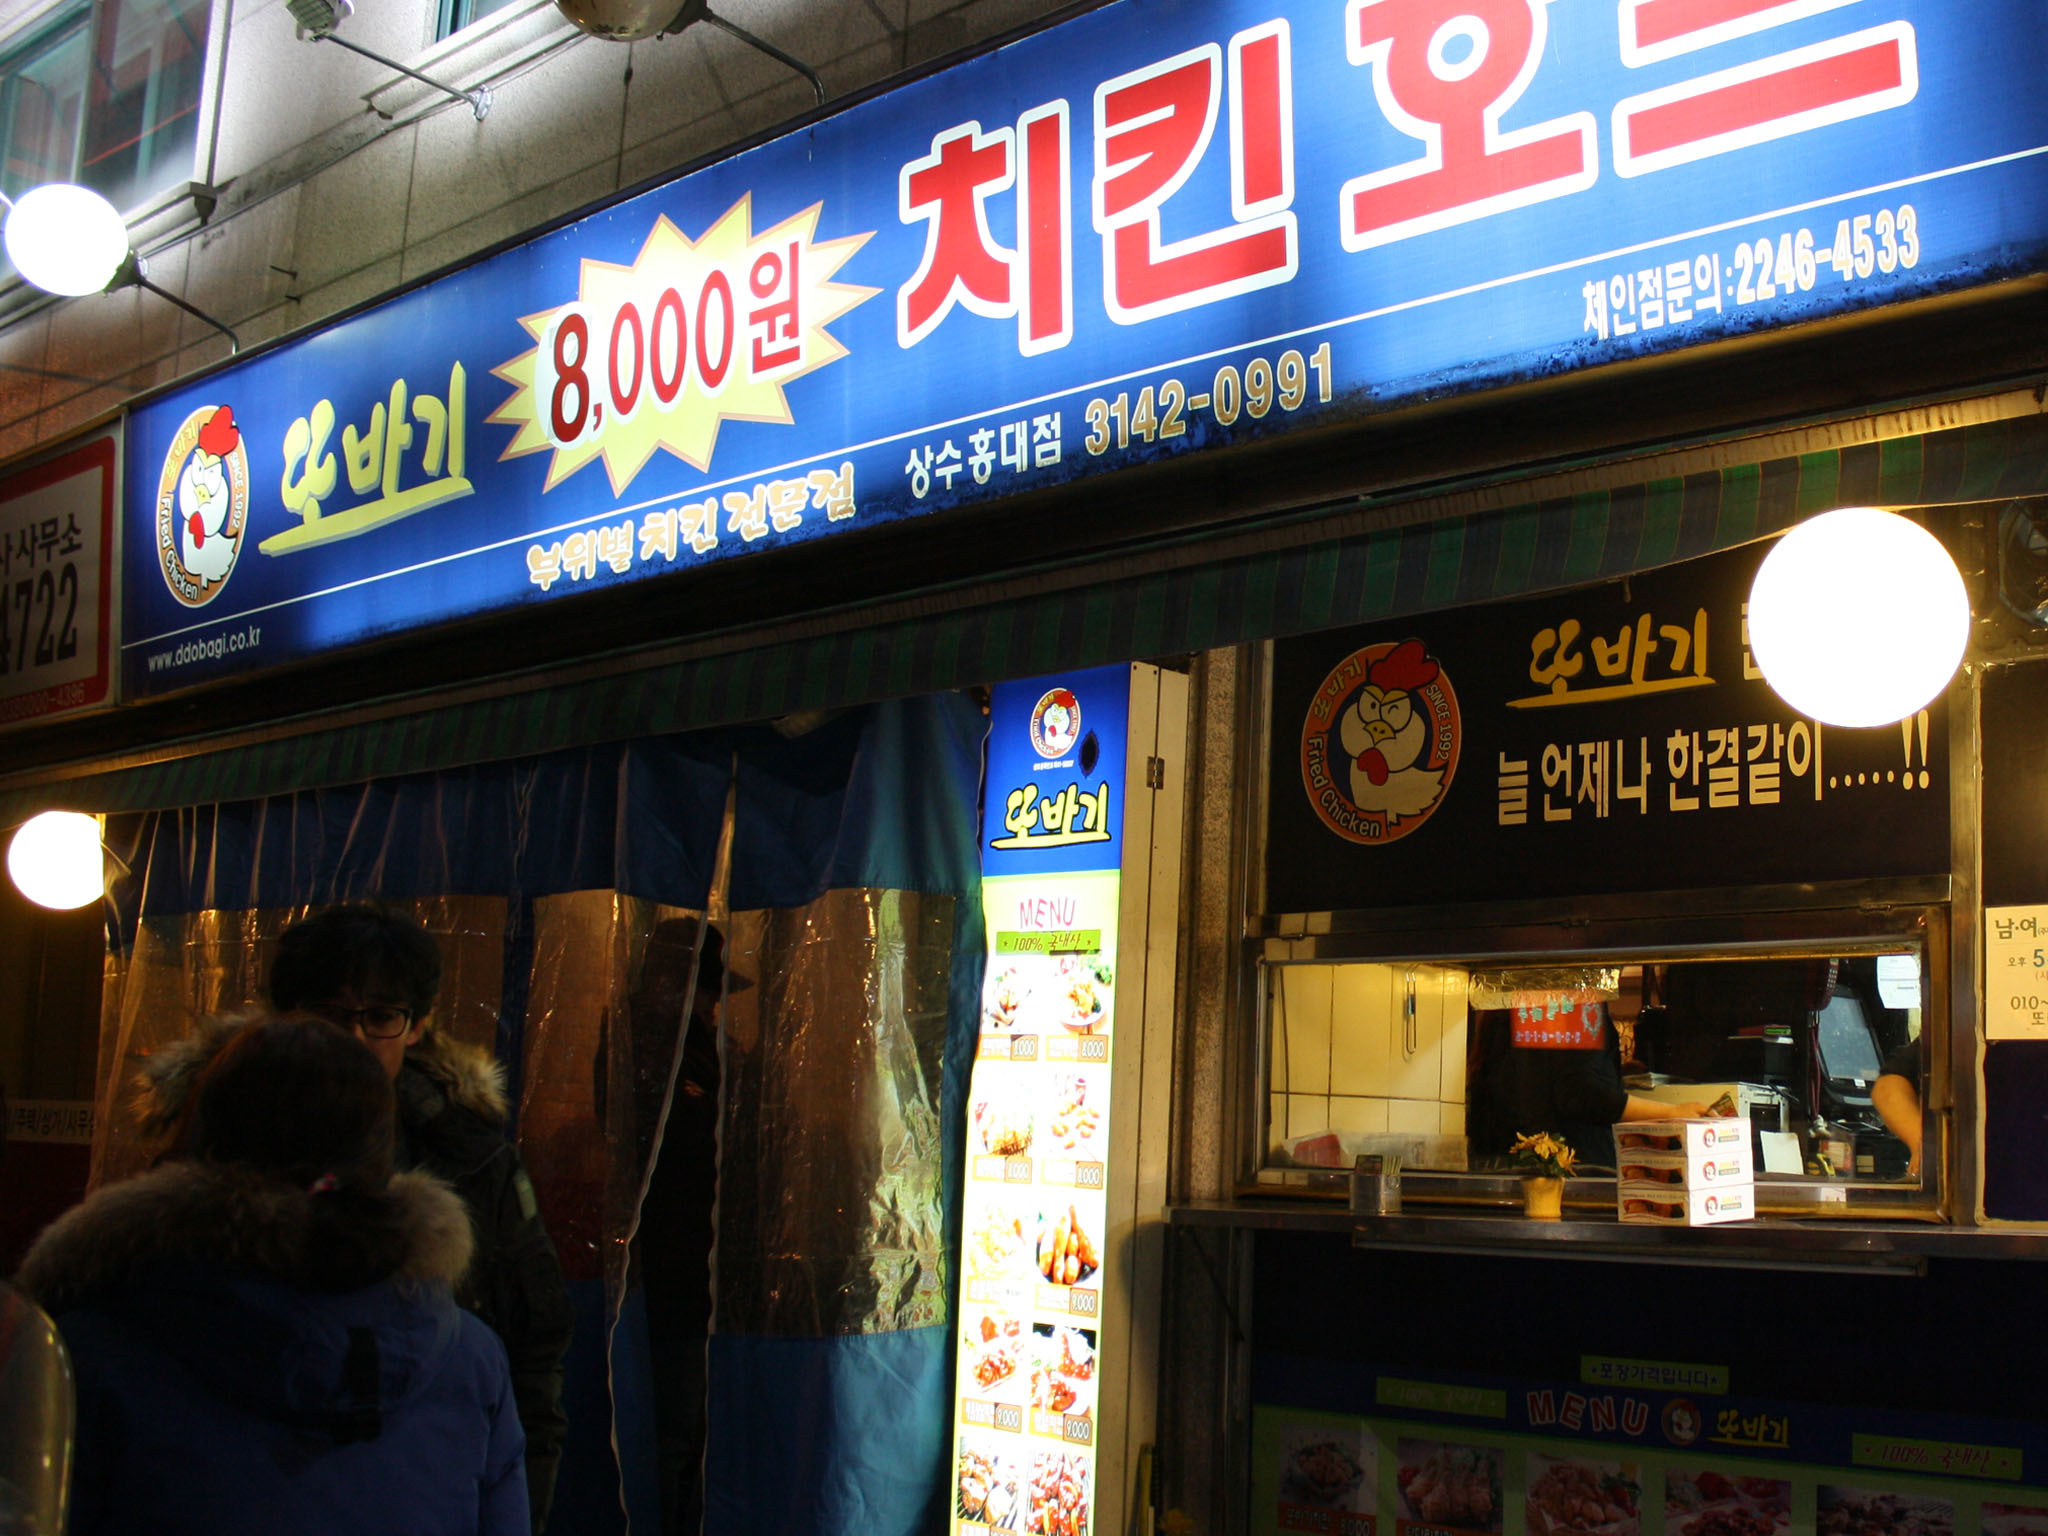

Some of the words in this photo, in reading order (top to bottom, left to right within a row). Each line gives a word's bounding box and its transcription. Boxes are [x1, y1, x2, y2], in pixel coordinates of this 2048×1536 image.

[547, 238, 804, 445] 8,000원
[1084, 342, 1333, 456] 3142-0991
[258, 361, 475, 556] 또바기
[159, 496, 173, 549] Fried
[526, 519, 634, 592] 부위별
[639, 497, 719, 561] 치킨
[723, 461, 857, 543] 전문점
[164, 549, 199, 601] Chicken
[147, 626, 261, 673] www.ddobagi.co.kr
[1505, 607, 1717, 709] 또바기
[1425, 683, 1451, 722] SINCE
[1435, 723, 1454, 760] 1992
[1307, 735, 1330, 790] Fried
[1319, 788, 1381, 838] Chicken
[1497, 751, 1530, 826] 늘
[1540, 736, 1652, 823] 언제나
[990, 781, 1112, 850] 또바기
[1019, 896, 1076, 929] MENU
[1013, 937, 1044, 952] 100%
[2007, 956, 2027, 968] 오후
[1601, 1361, 1709, 1388] 포장가격입니다
[1525, 1389, 1650, 1437] MENU
[1706, 1408, 1791, 1448] 또바기
[1879, 1444, 1930, 1466] 100%
[1937, 1445, 1993, 1474] 국내산
